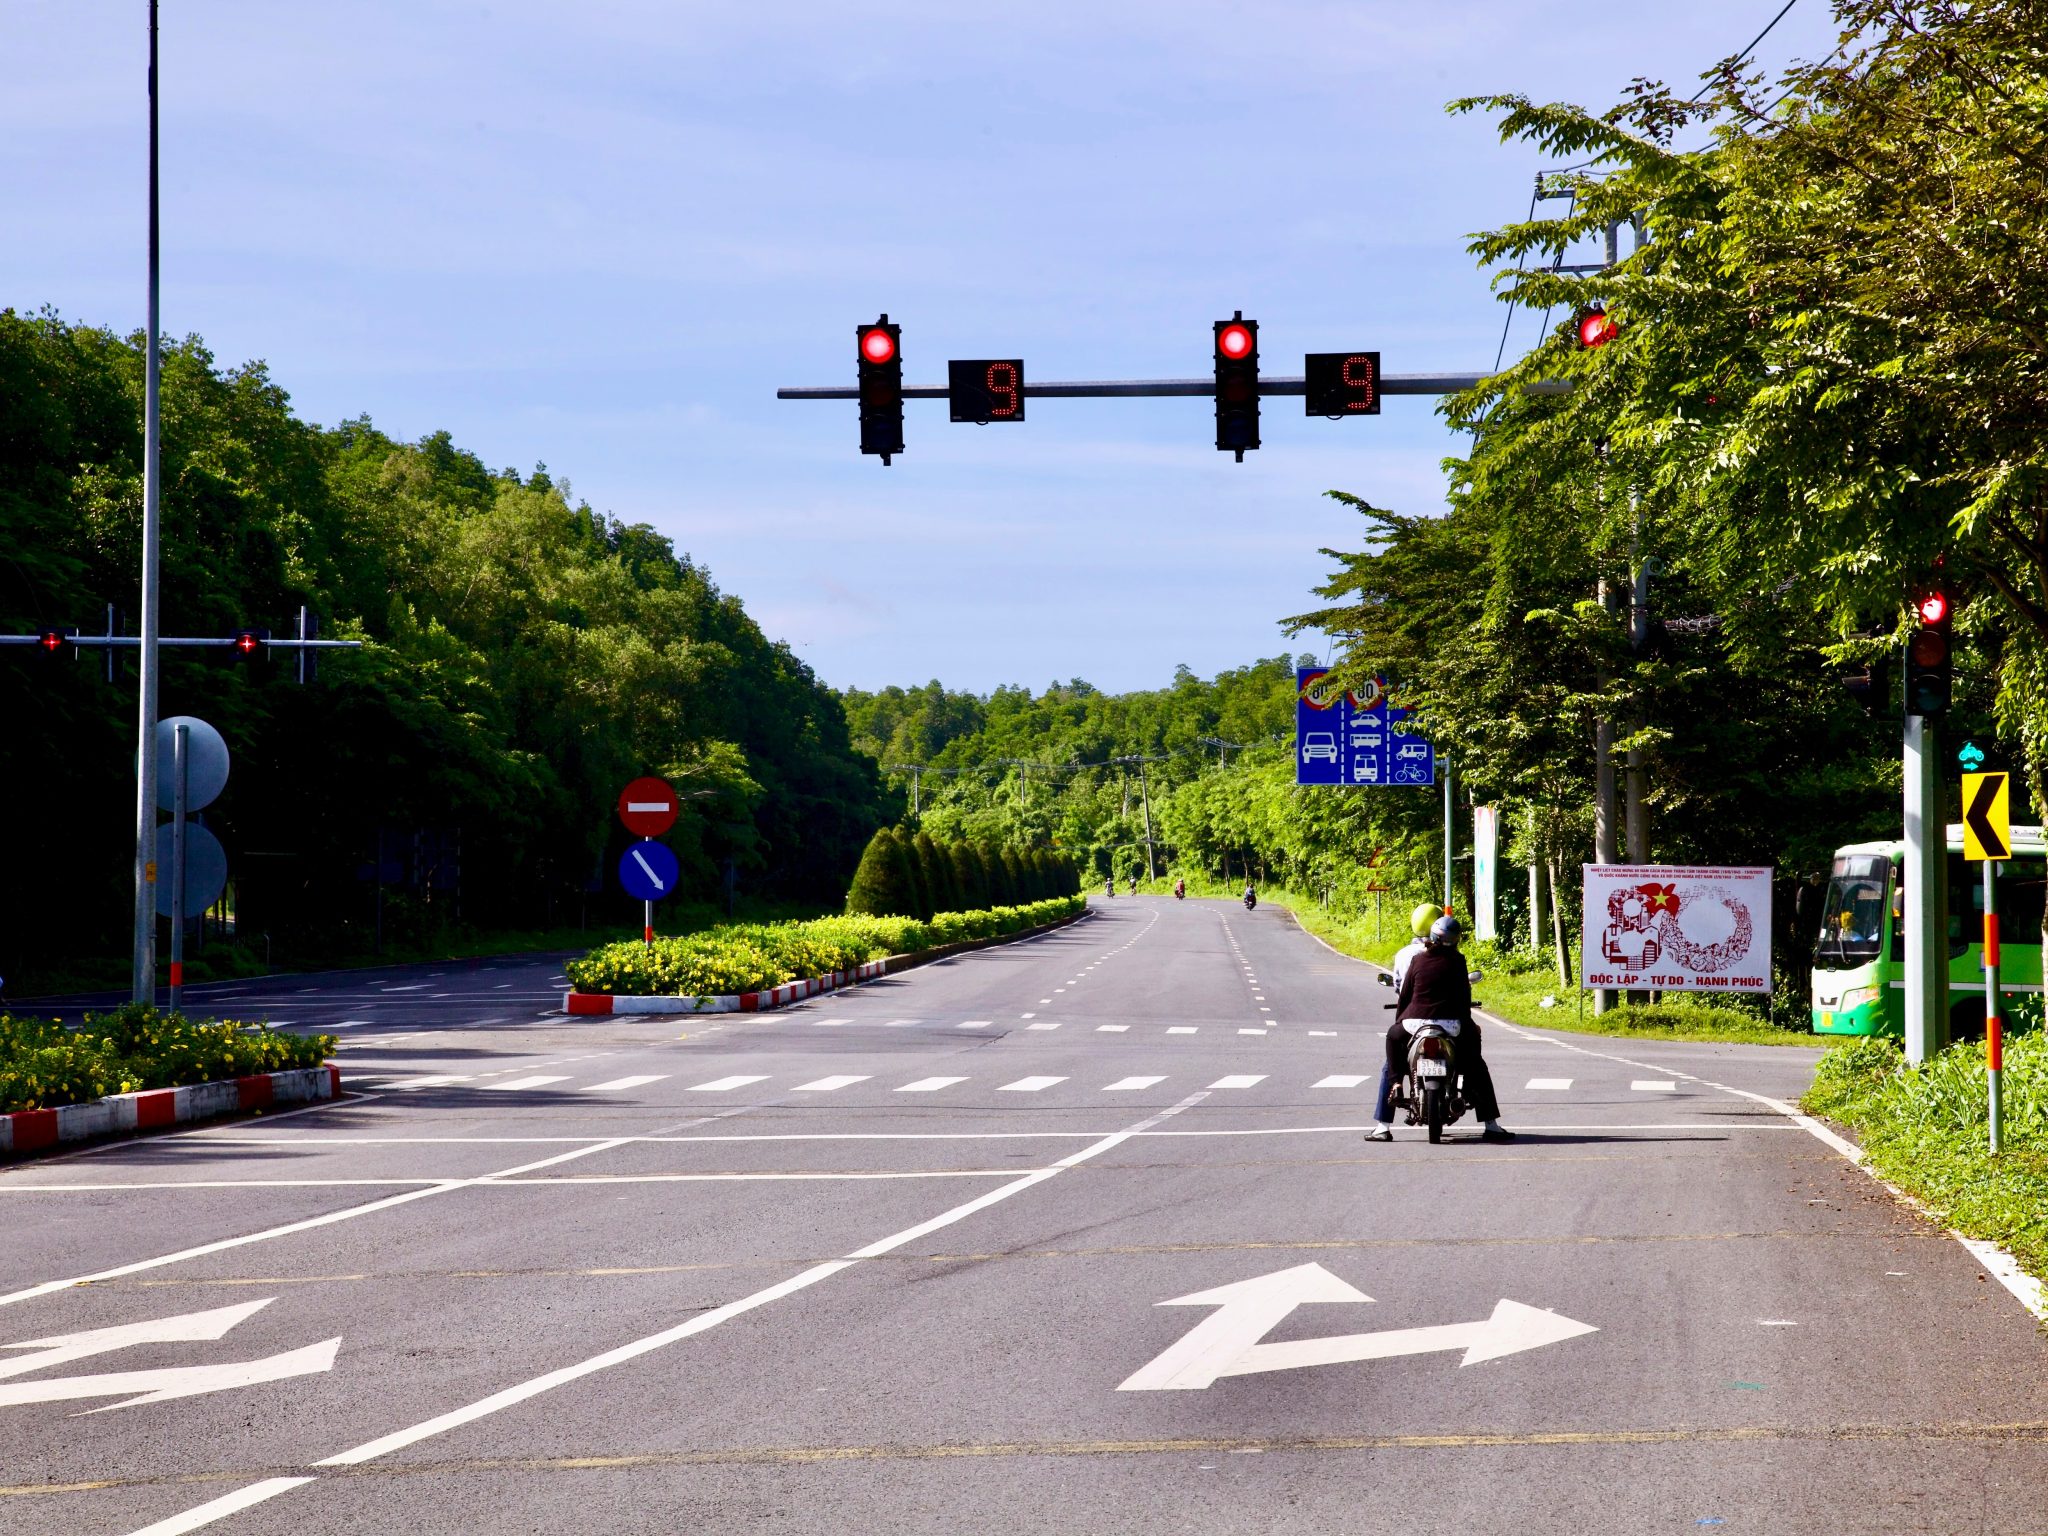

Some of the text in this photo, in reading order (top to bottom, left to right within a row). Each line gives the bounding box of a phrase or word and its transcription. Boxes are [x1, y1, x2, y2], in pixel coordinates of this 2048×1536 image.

[987, 363, 1017, 415] 9
[1343, 357, 1373, 409] 9
[1590, 973, 1613, 986] ĐỘC
[1617, 973, 1639, 986] LẬP
[1650, 974, 1666, 987] TỰ
[1668, 975, 1684, 986] DO
[1696, 976, 1728, 988] HẠNH
[1732, 975, 1764, 987] PHÚC
